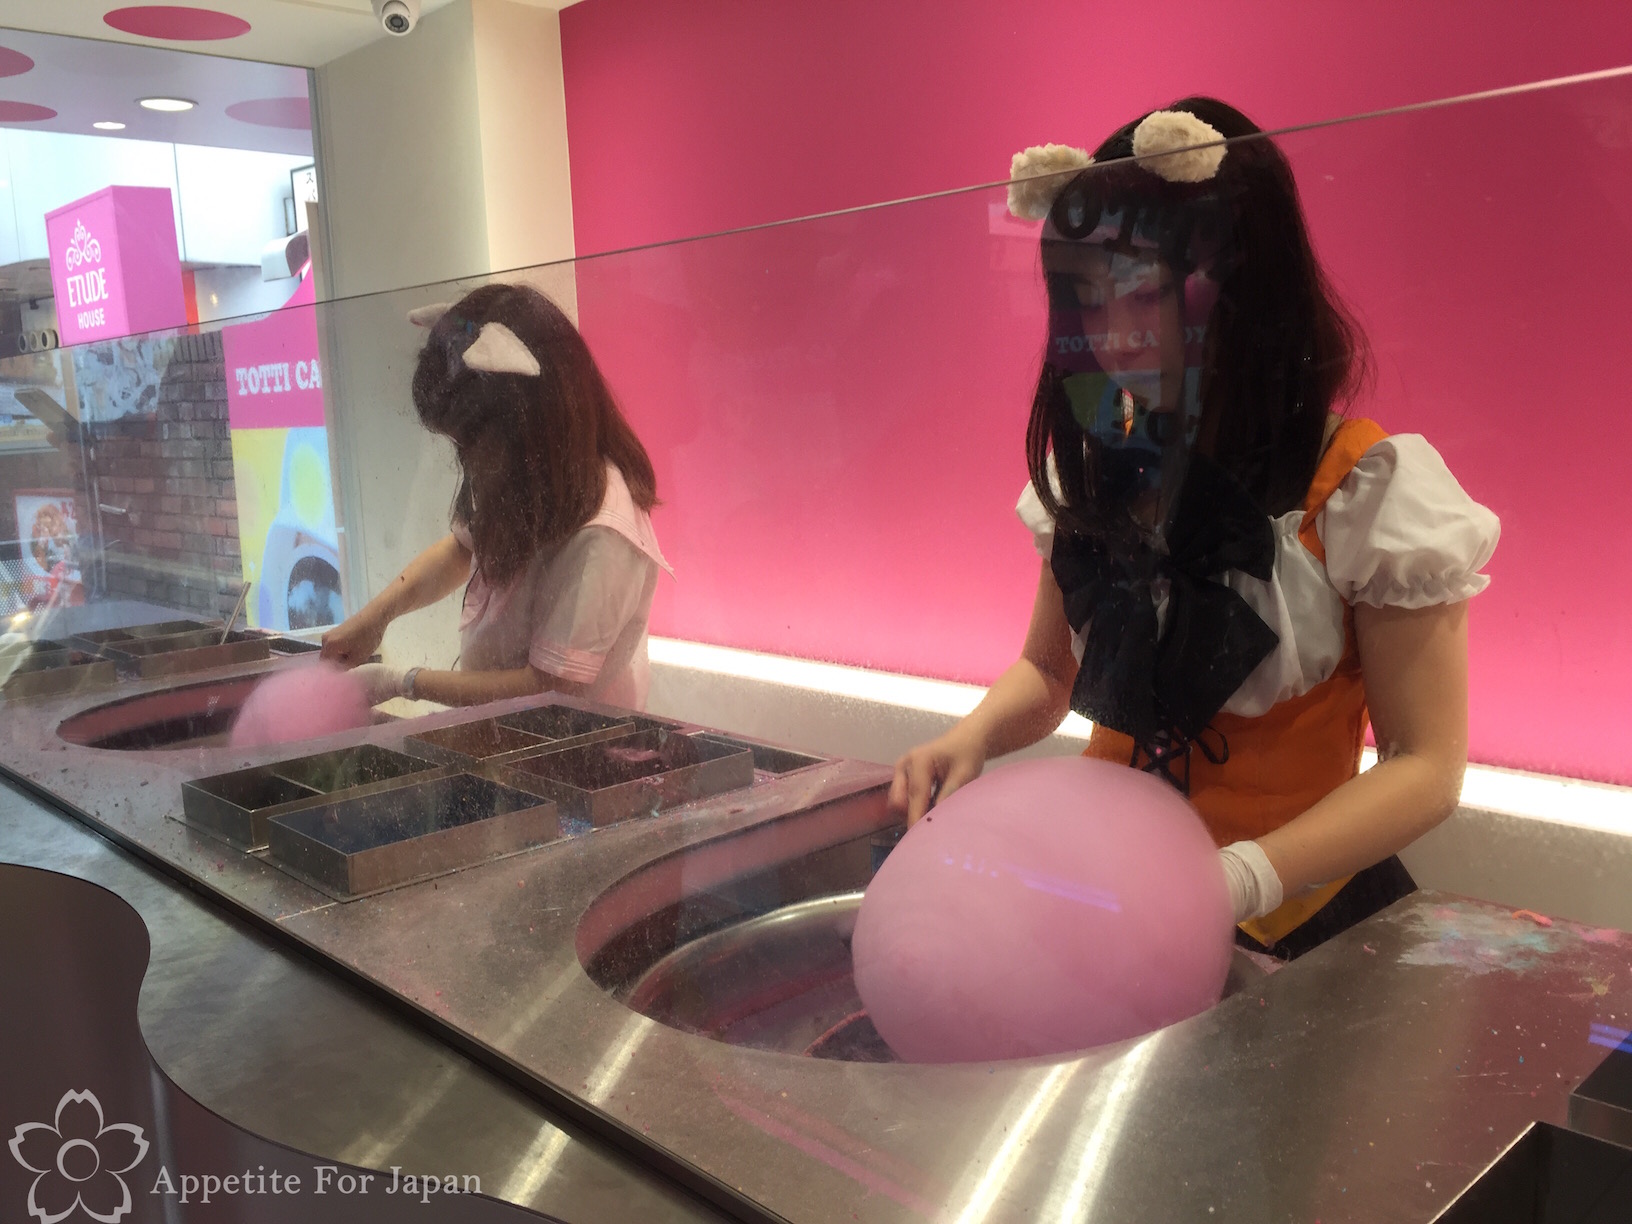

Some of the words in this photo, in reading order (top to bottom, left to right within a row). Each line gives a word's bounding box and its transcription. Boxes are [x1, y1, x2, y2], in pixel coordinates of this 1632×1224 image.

[66, 267, 109, 308] ETUDE
[77, 307, 106, 330] HOUSE
[1056, 332, 1120, 353] TOTTI
[235, 362, 292, 396] TOTTI
